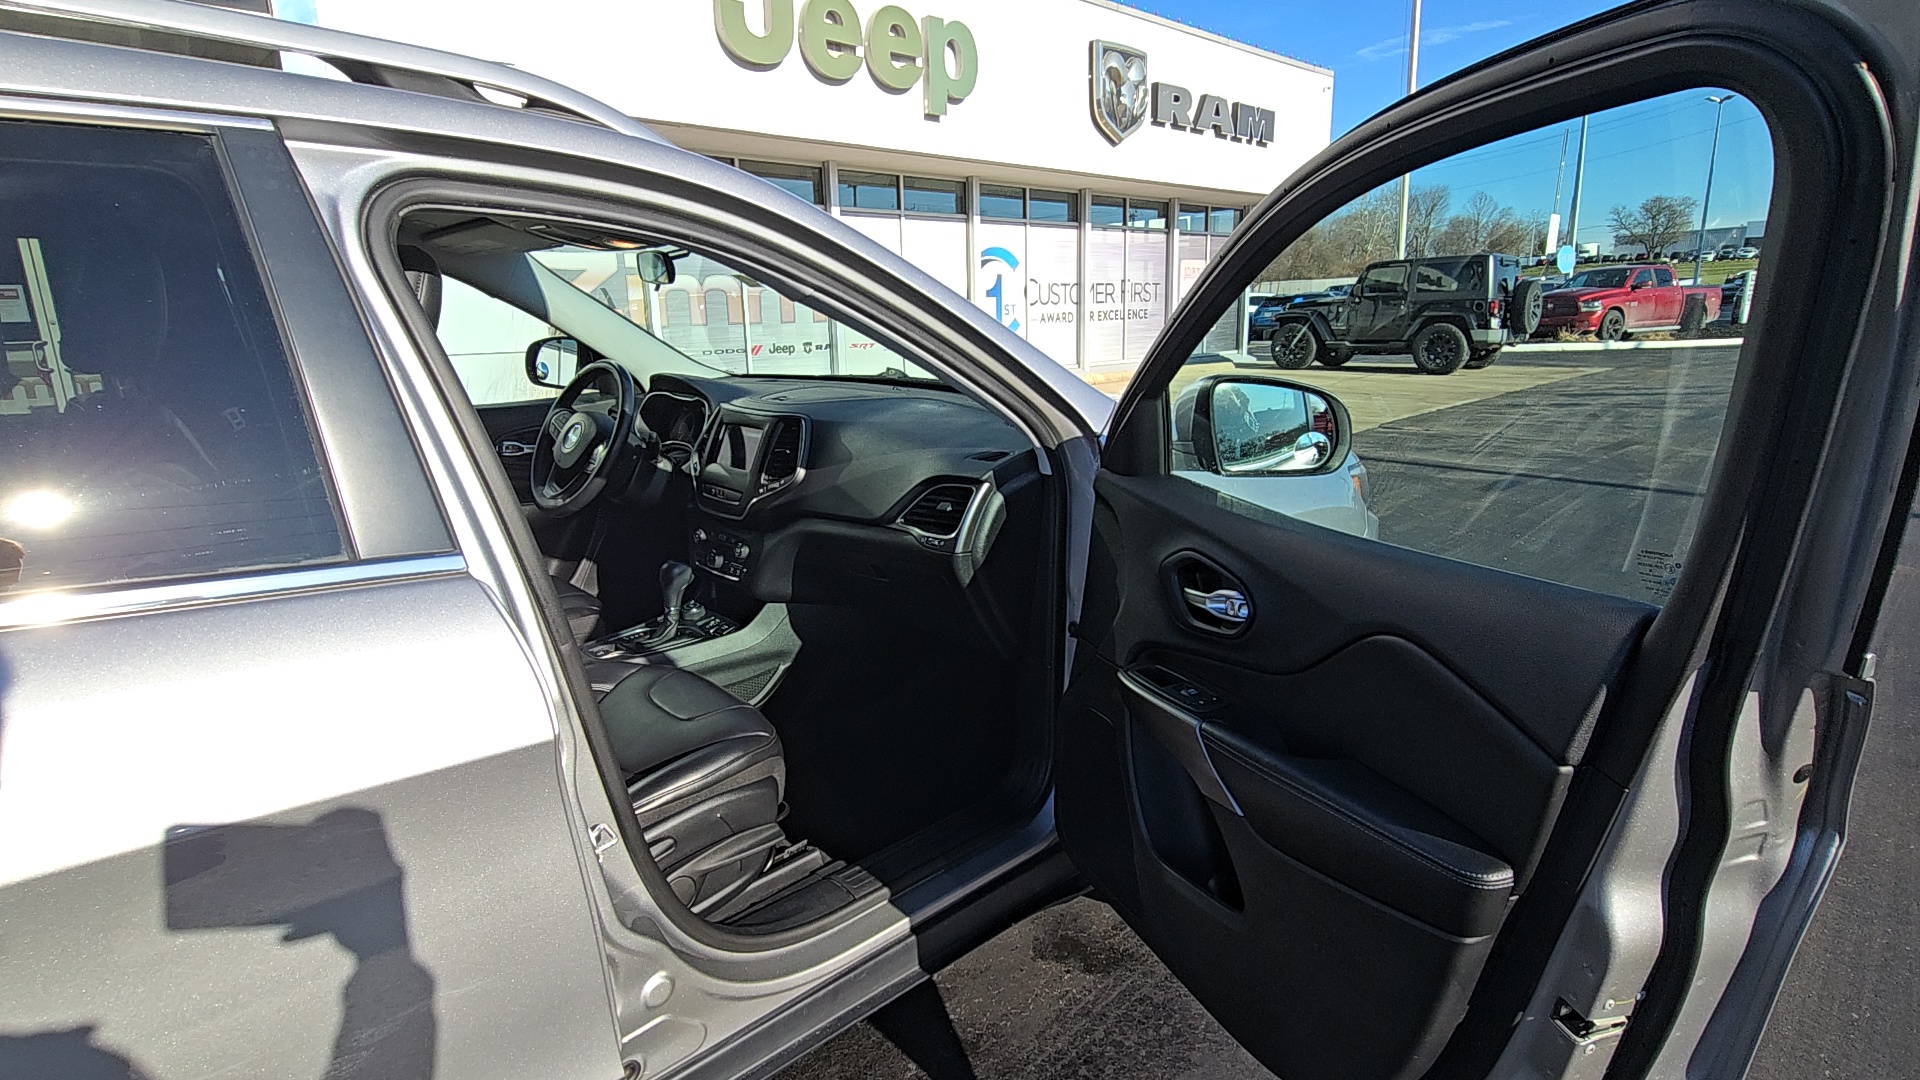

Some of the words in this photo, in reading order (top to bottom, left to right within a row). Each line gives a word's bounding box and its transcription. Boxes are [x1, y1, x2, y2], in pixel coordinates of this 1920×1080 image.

[713, 0, 979, 117] Jeep
[1151, 82, 1276, 145] RAM
[1039, 311, 1074, 324] AWARD
[1097, 308, 1149, 322] EXCELENCE
[768, 342, 796, 356] Jeep
[849, 342, 877, 350] SRT
